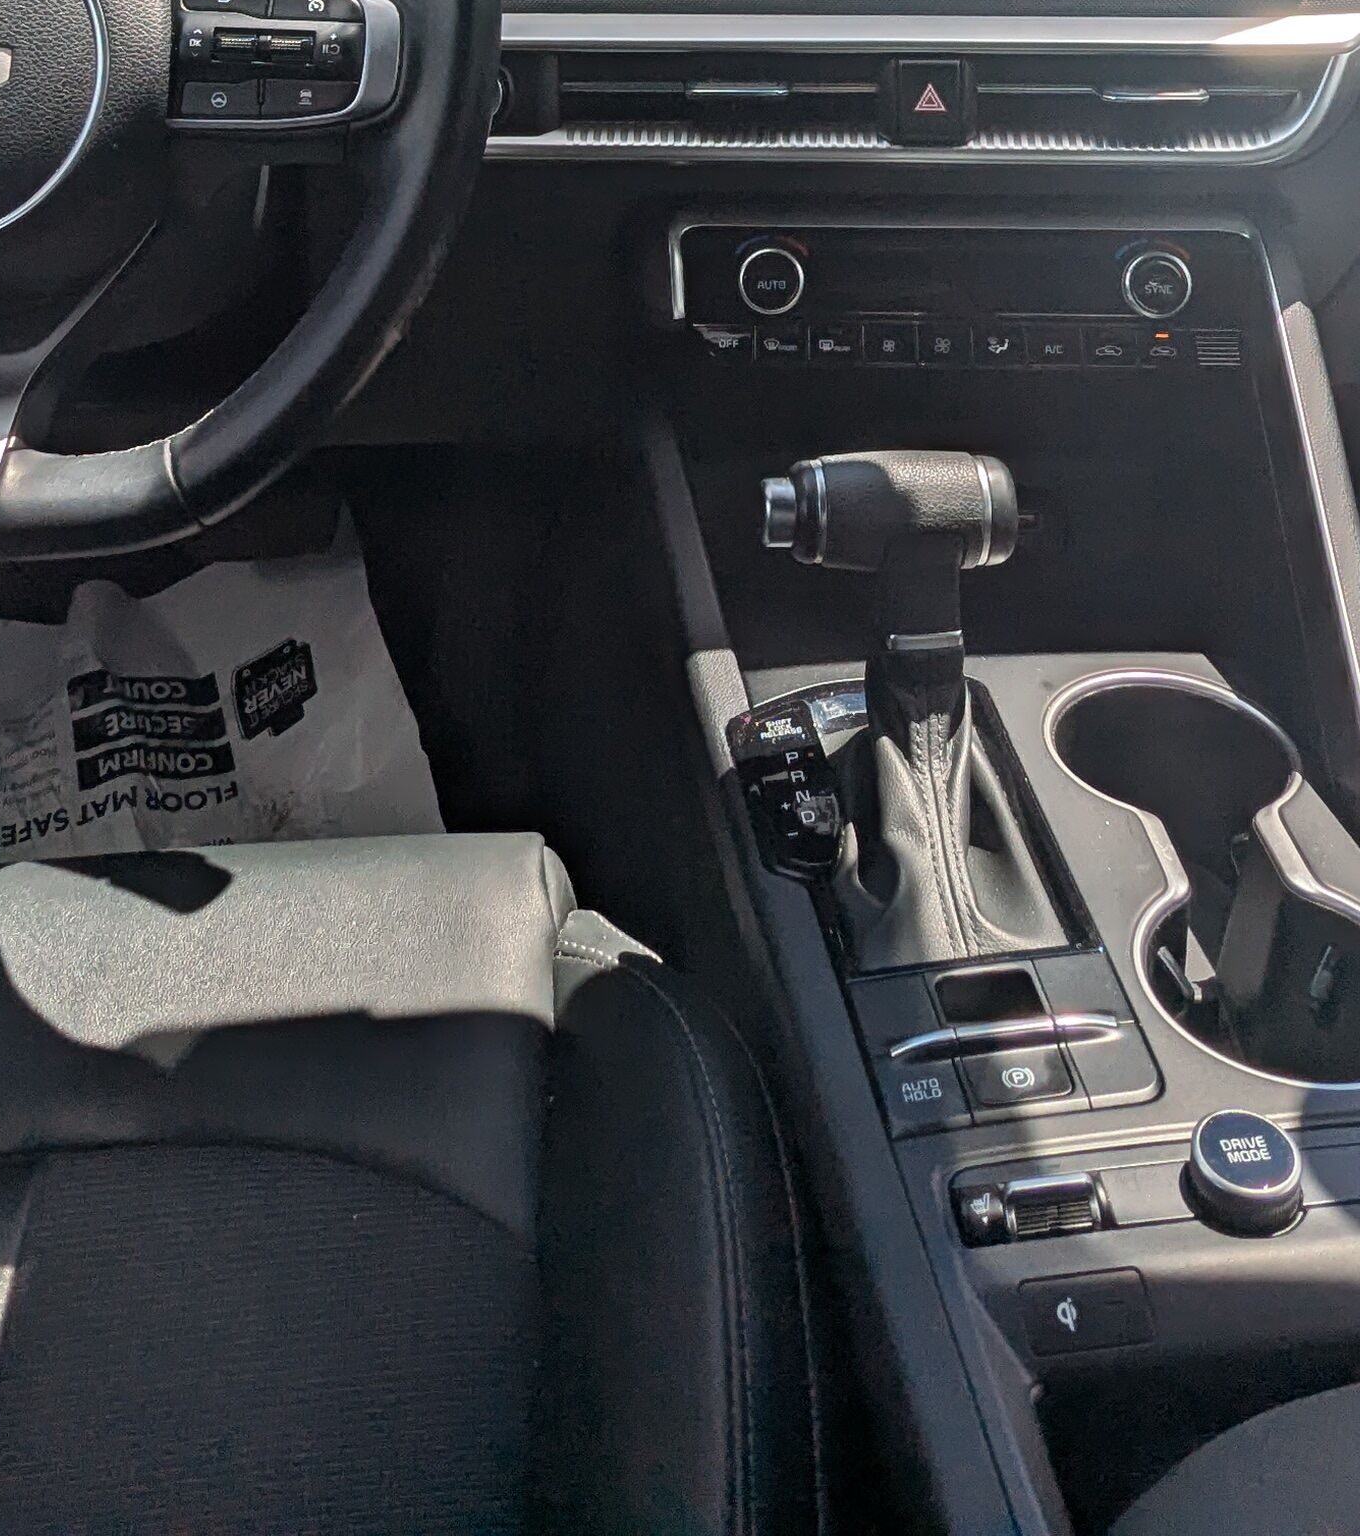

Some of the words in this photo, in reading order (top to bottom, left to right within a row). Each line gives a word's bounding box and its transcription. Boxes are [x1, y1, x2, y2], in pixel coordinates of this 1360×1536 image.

[757, 280, 787, 290] AUTO
[1143, 284, 1174, 295] SYNC
[718, 339, 739, 349] OFF
[1045, 344, 1064, 355] A/C
[243, 665, 308, 715] NEVER
[97, 746, 213, 776] CONFIRM
[785, 751, 799, 765] P
[790, 770, 806, 783] R
[145, 781, 240, 813] FLOOR
[795, 789, 811, 803] N
[74, 784, 138, 831] MAT
[800, 810, 816, 824] D
[902, 1077, 940, 1094] AUTO
[904, 1088, 942, 1103] HOLD
[1219, 1134, 1267, 1154] DRIVE
[1226, 1146, 1272, 1165] MODE
